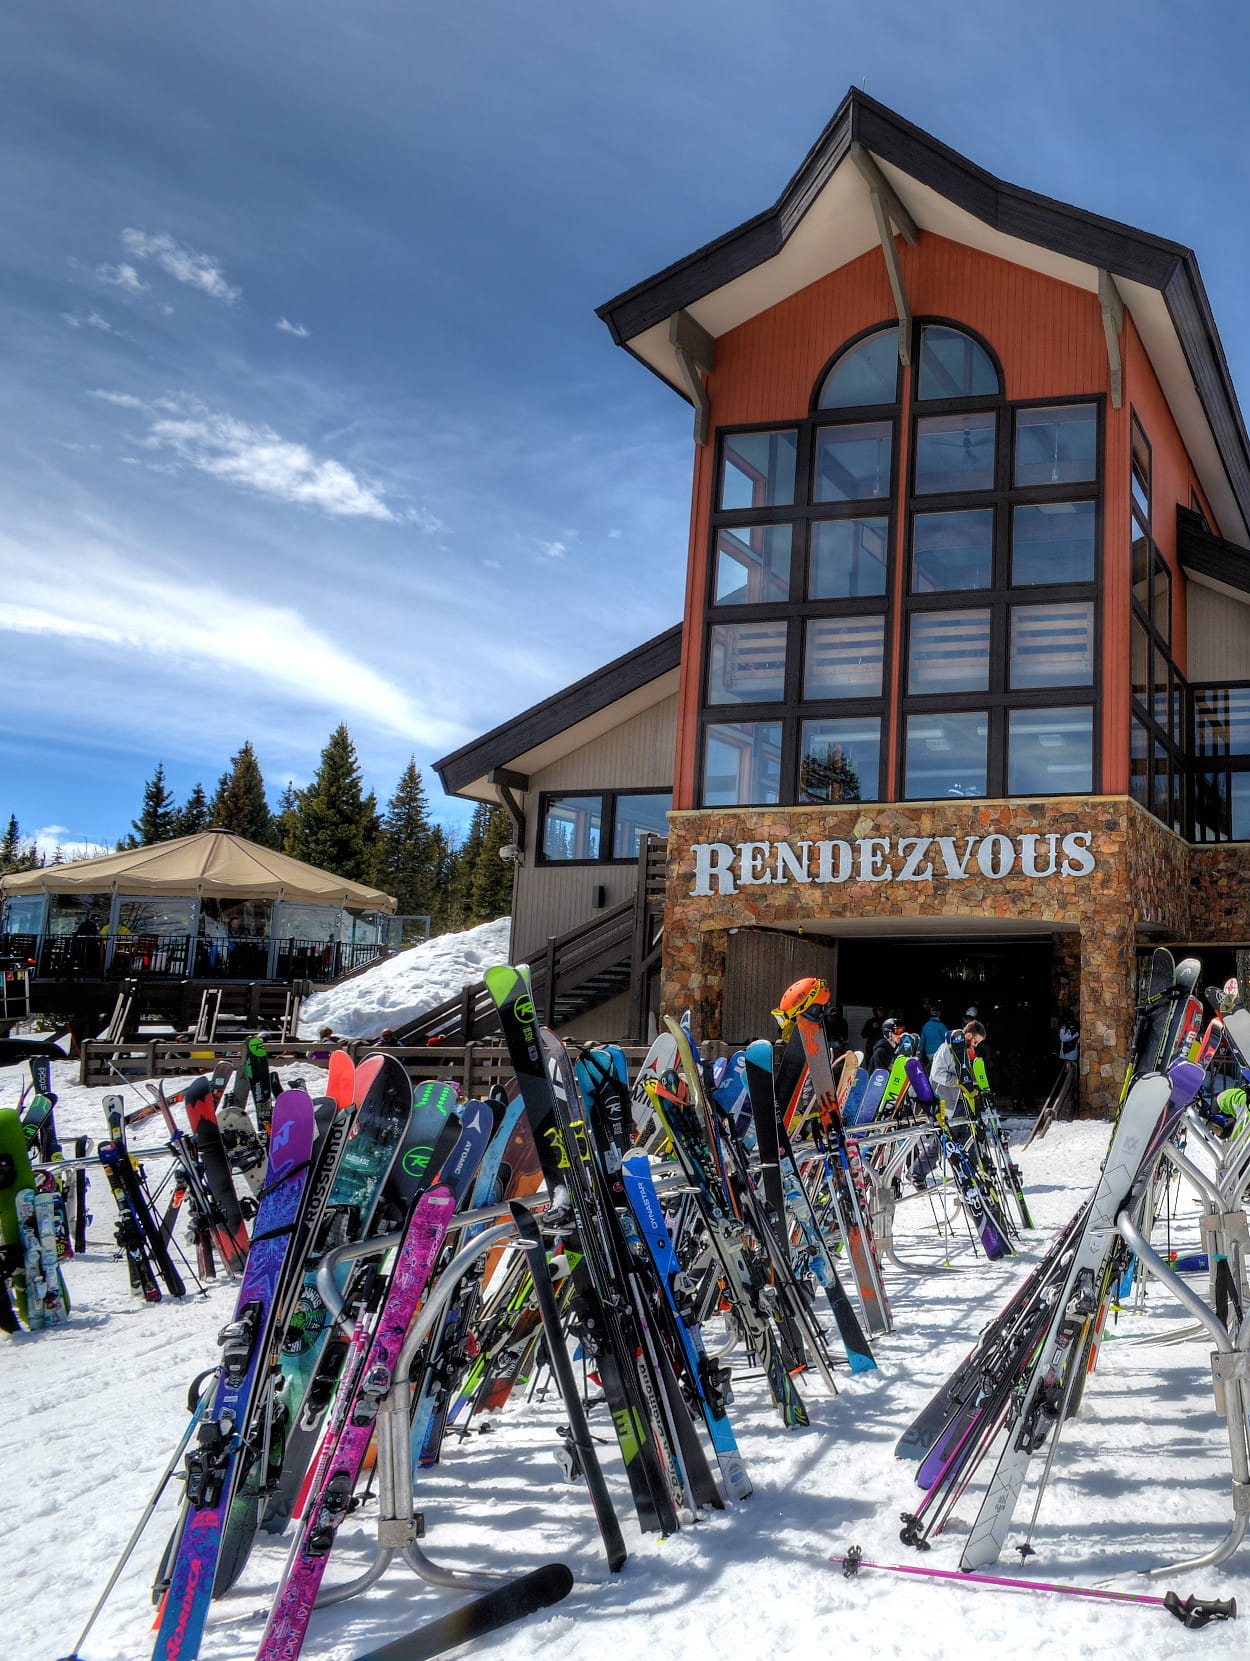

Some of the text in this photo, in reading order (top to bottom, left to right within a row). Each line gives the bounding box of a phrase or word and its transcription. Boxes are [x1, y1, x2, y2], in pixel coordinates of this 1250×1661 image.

[689, 830, 1097, 897] RENDEZVOUS
[306, 1117, 347, 1222] ROSSIGNOL
[454, 1140, 472, 1175] ATOMIC
[638, 1182, 659, 1230] DYNASTAR
[426, 1223, 444, 1266] FISCHER
[166, 1560, 202, 1661] NORDICA
